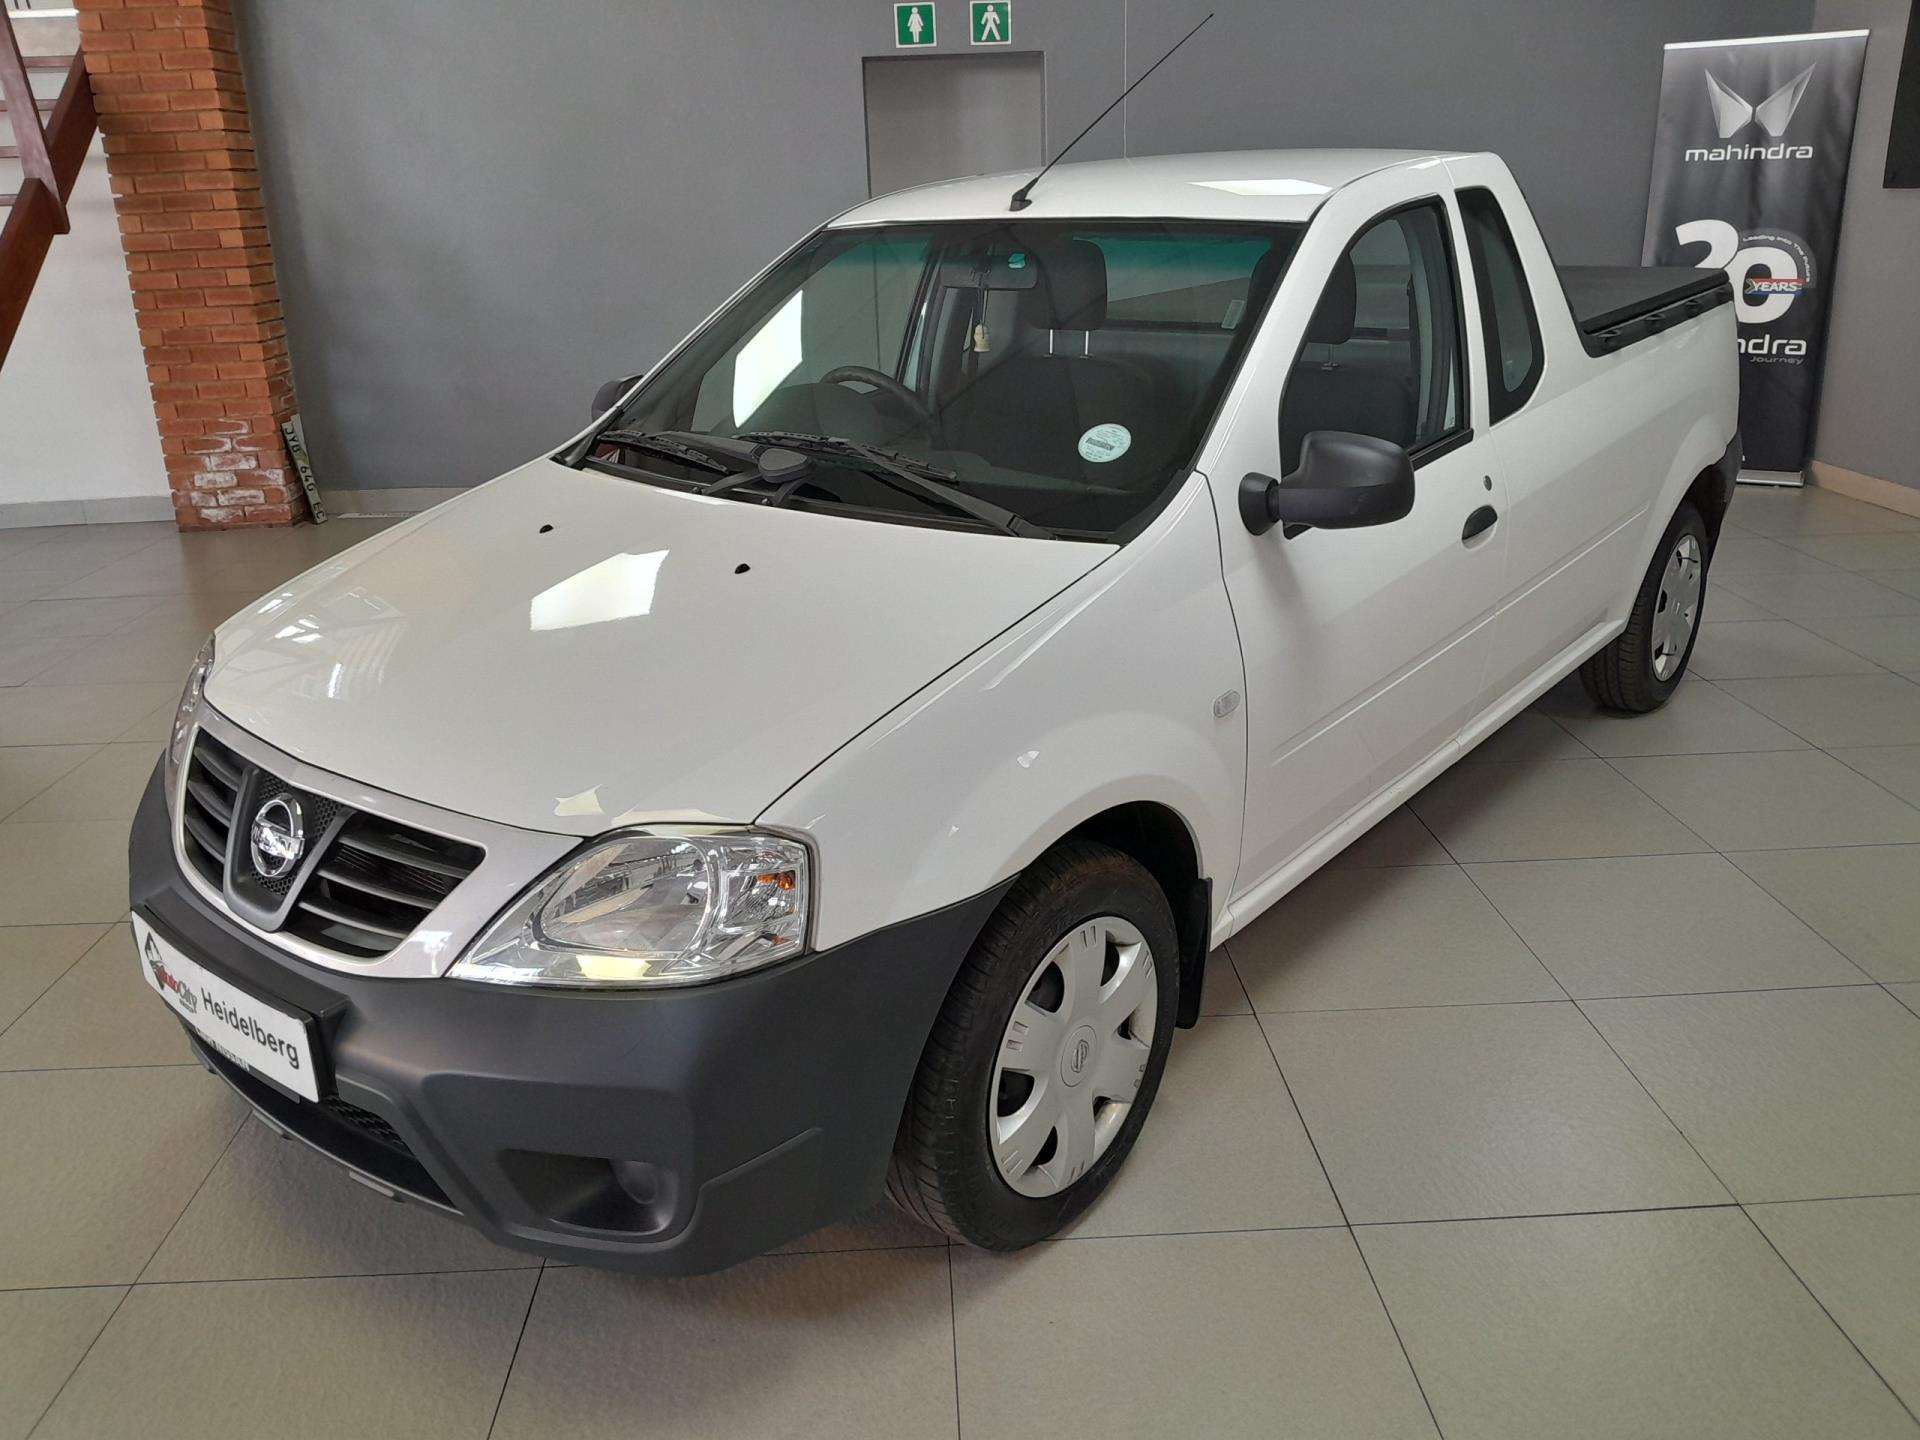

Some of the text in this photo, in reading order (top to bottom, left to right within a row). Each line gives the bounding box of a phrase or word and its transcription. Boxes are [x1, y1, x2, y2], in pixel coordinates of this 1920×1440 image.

[1685, 143, 1814, 161] mahindra
[1753, 281, 1801, 292] YEARS
[201, 987, 299, 1070] Heidelberg
